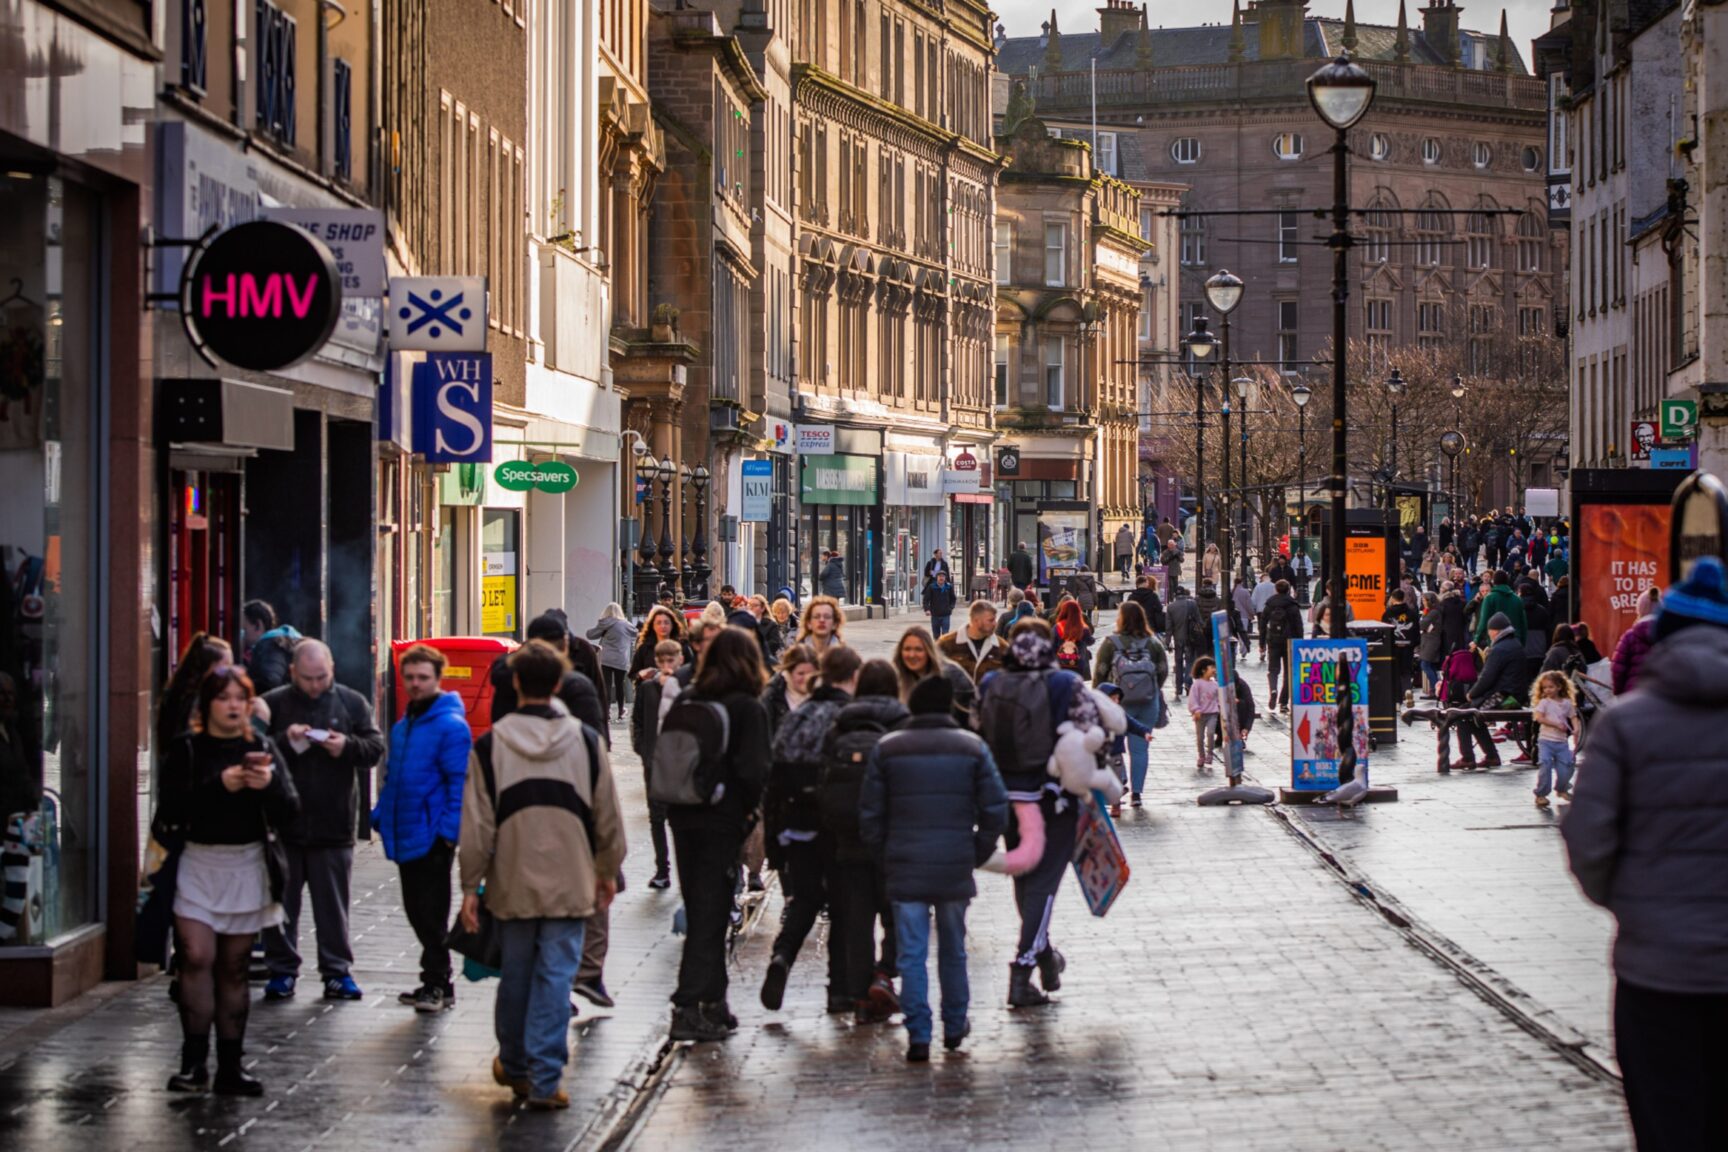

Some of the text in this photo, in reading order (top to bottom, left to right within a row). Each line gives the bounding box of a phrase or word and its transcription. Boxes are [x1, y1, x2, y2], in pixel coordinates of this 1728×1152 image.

[326, 223, 376, 241] SHOP
[202, 272, 319, 318] HMV
[435, 359, 481, 380] WH
[435, 381, 484, 456] S
[1669, 406, 1690, 426] D
[800, 441, 830, 449] express
[502, 468, 569, 484] Specsavers
[1611, 561, 1657, 575] IT HAS
[1614, 577, 1654, 591] TO BE
[489, 590, 506, 607] LET
[1610, 593, 1639, 610] BRE
[1299, 647, 1362, 662] YVONE'S
[1300, 662, 1360, 684] FANY
[1301, 683, 1360, 703] DRES
